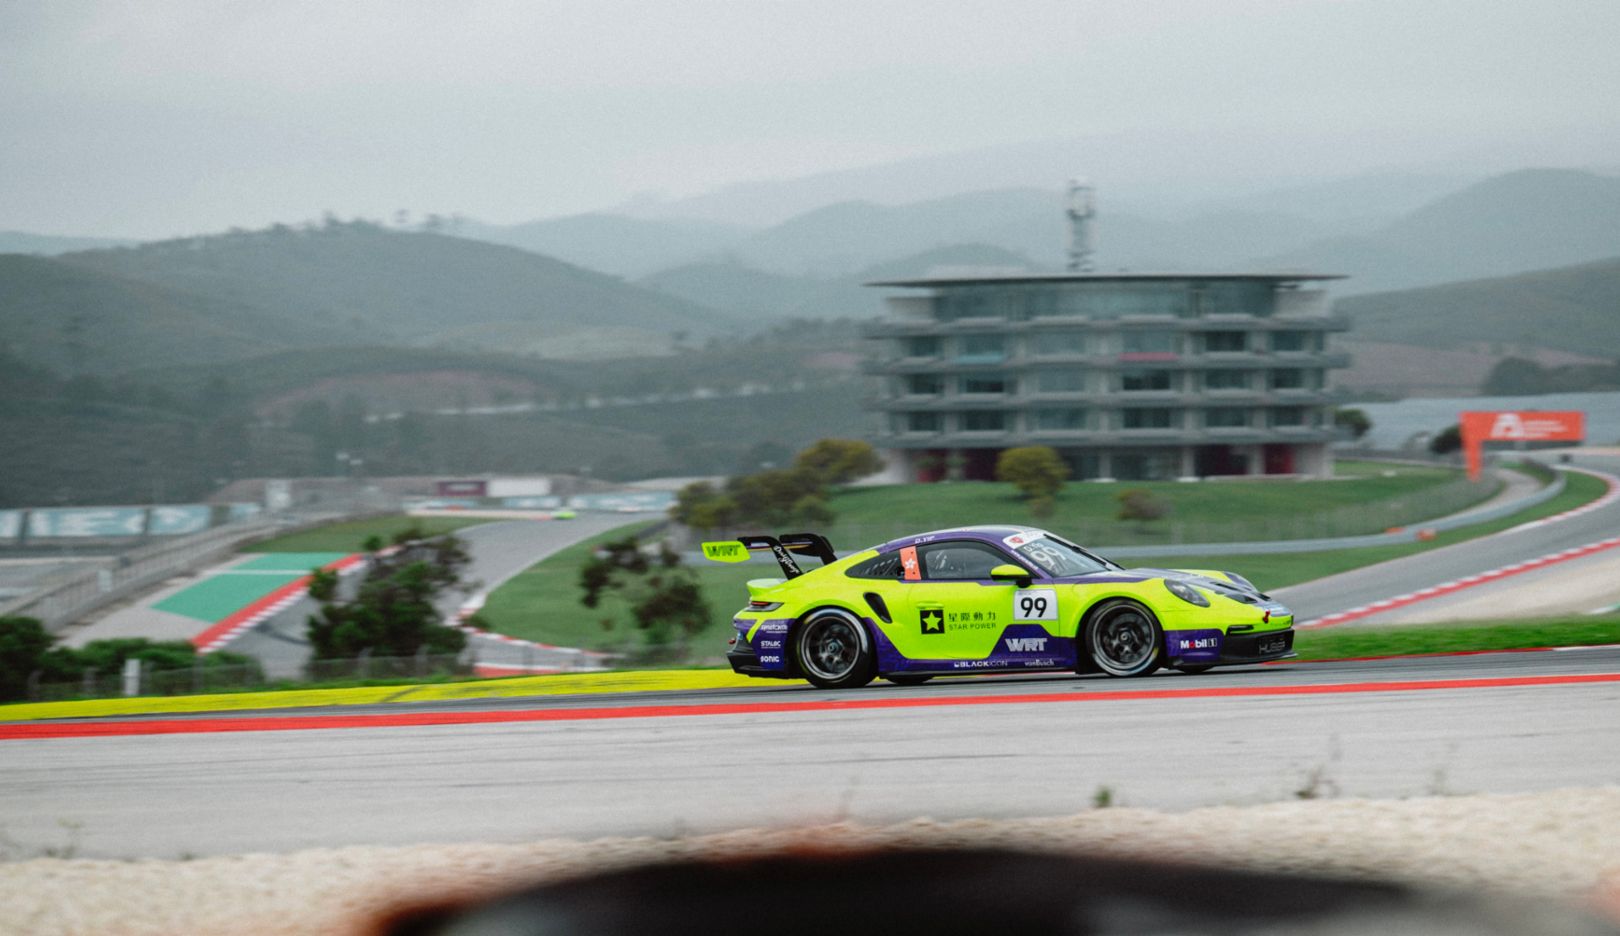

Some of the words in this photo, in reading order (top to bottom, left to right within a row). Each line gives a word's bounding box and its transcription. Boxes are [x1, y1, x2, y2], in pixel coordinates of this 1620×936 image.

[705, 545, 741, 557] WRT
[1020, 596, 1047, 618] 99
[948, 623, 968, 631] STAR
[970, 622, 996, 630] POWER
[1004, 637, 1048, 652] WRT
[1180, 638, 1207, 650] Mobil
